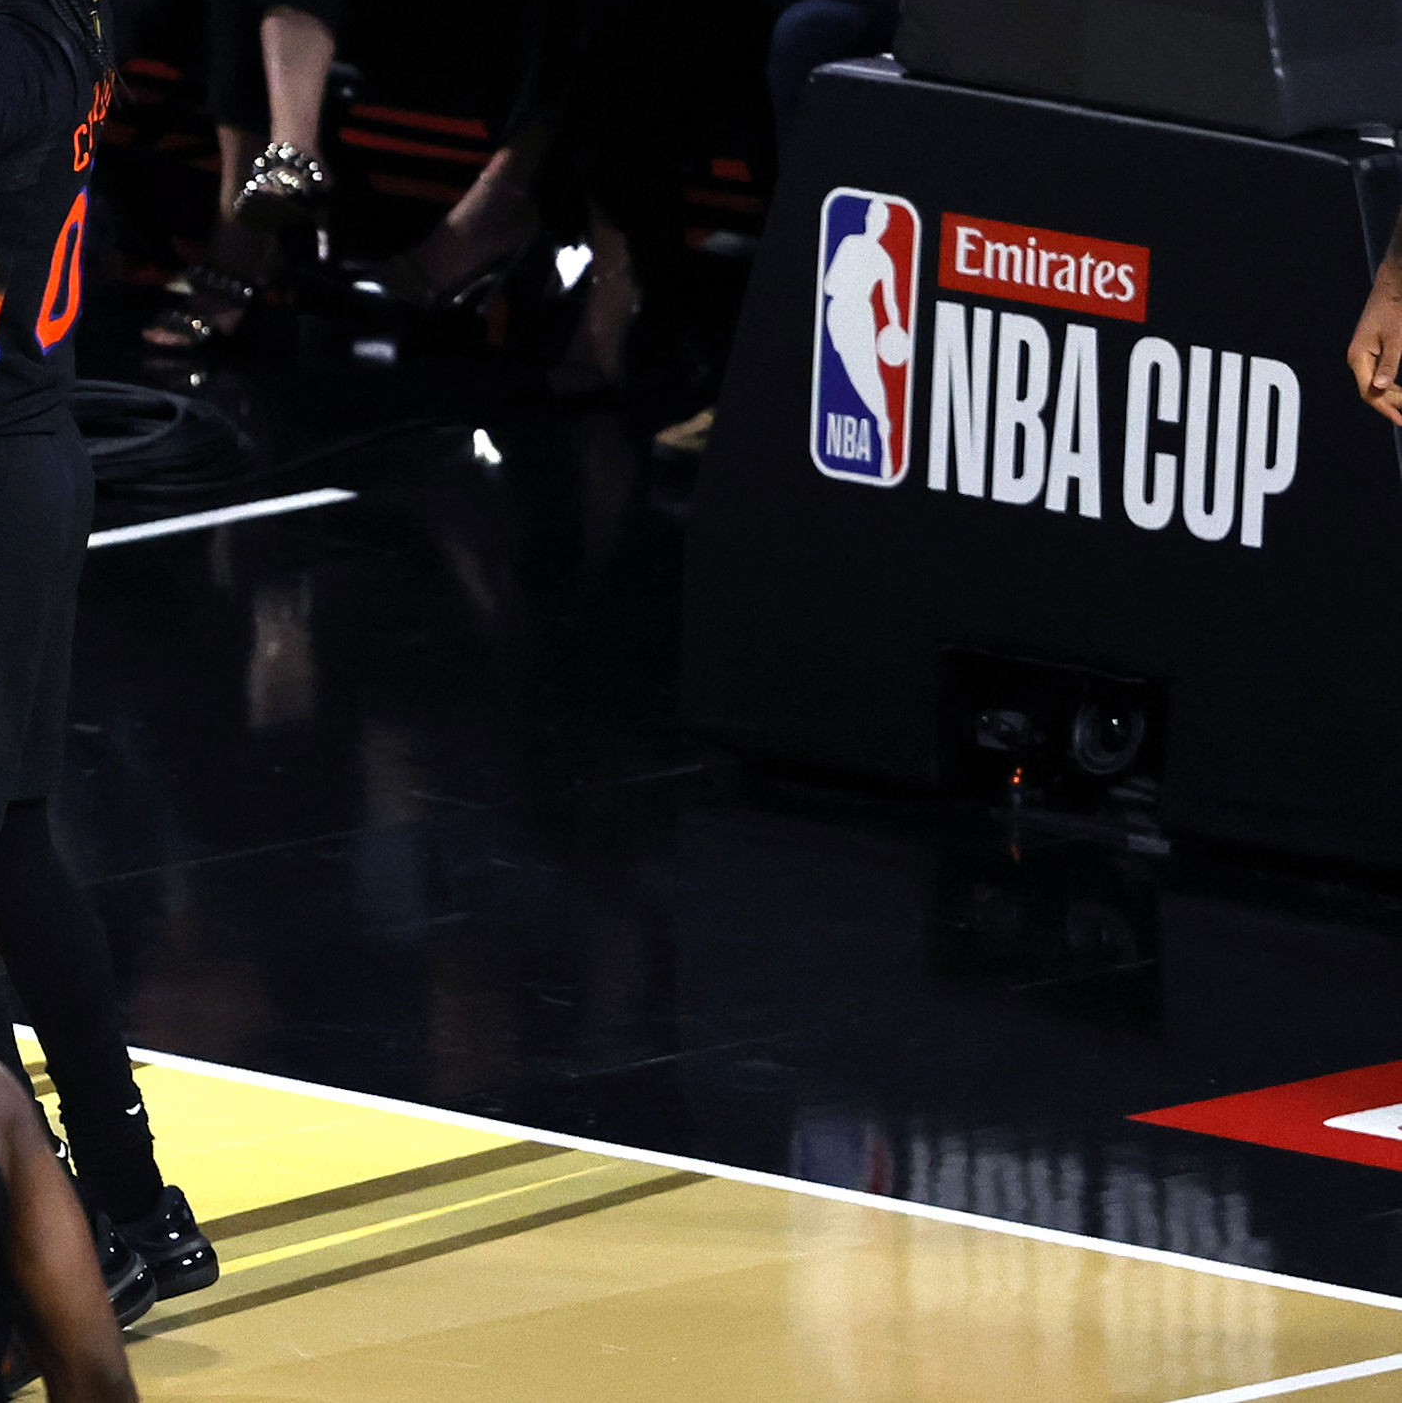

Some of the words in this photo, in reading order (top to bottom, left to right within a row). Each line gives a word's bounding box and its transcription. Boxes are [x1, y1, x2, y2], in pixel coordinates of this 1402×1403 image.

[954, 225, 1137, 303] Emirates
[825, 411, 872, 463] NBA
[927, 300, 1102, 520] NBA
[1123, 335, 1301, 548] CUP
